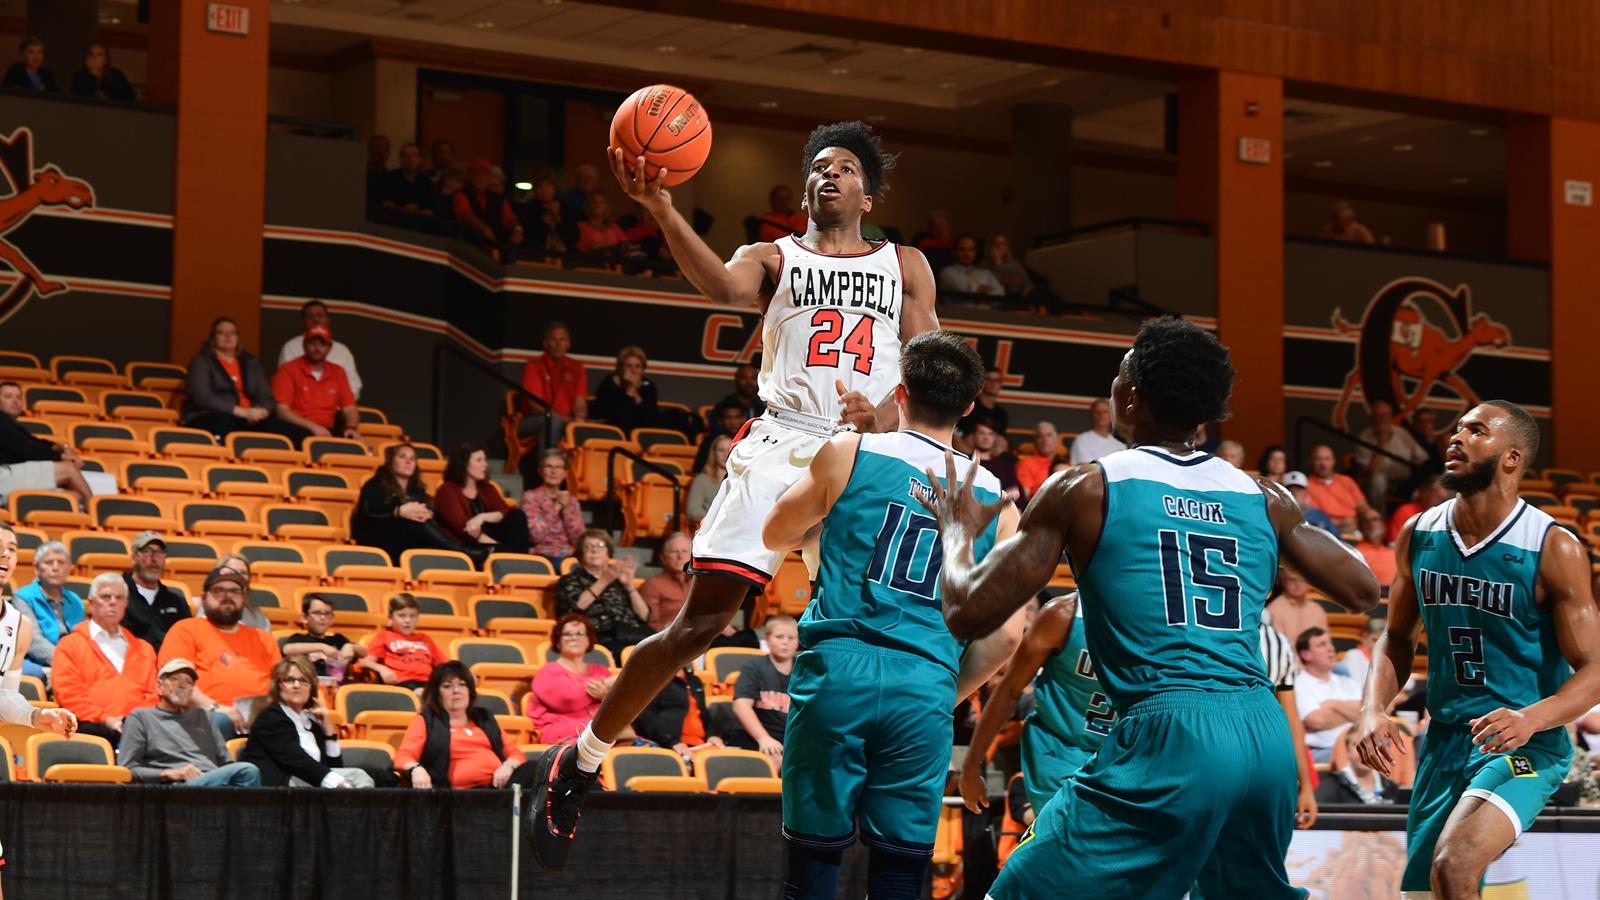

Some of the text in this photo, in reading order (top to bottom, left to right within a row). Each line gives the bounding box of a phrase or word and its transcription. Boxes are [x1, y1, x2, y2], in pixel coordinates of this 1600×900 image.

[216, 7, 243, 31] EXIT
[791, 266, 897, 321] CAMPBELL
[806, 308, 876, 377] 24
[1162, 494, 1227, 525] CACOK
[866, 501, 944, 601] 10
[1157, 528, 1243, 632] 15
[1419, 567, 1515, 620] UNCW
[1447, 626, 1487, 687] 2
